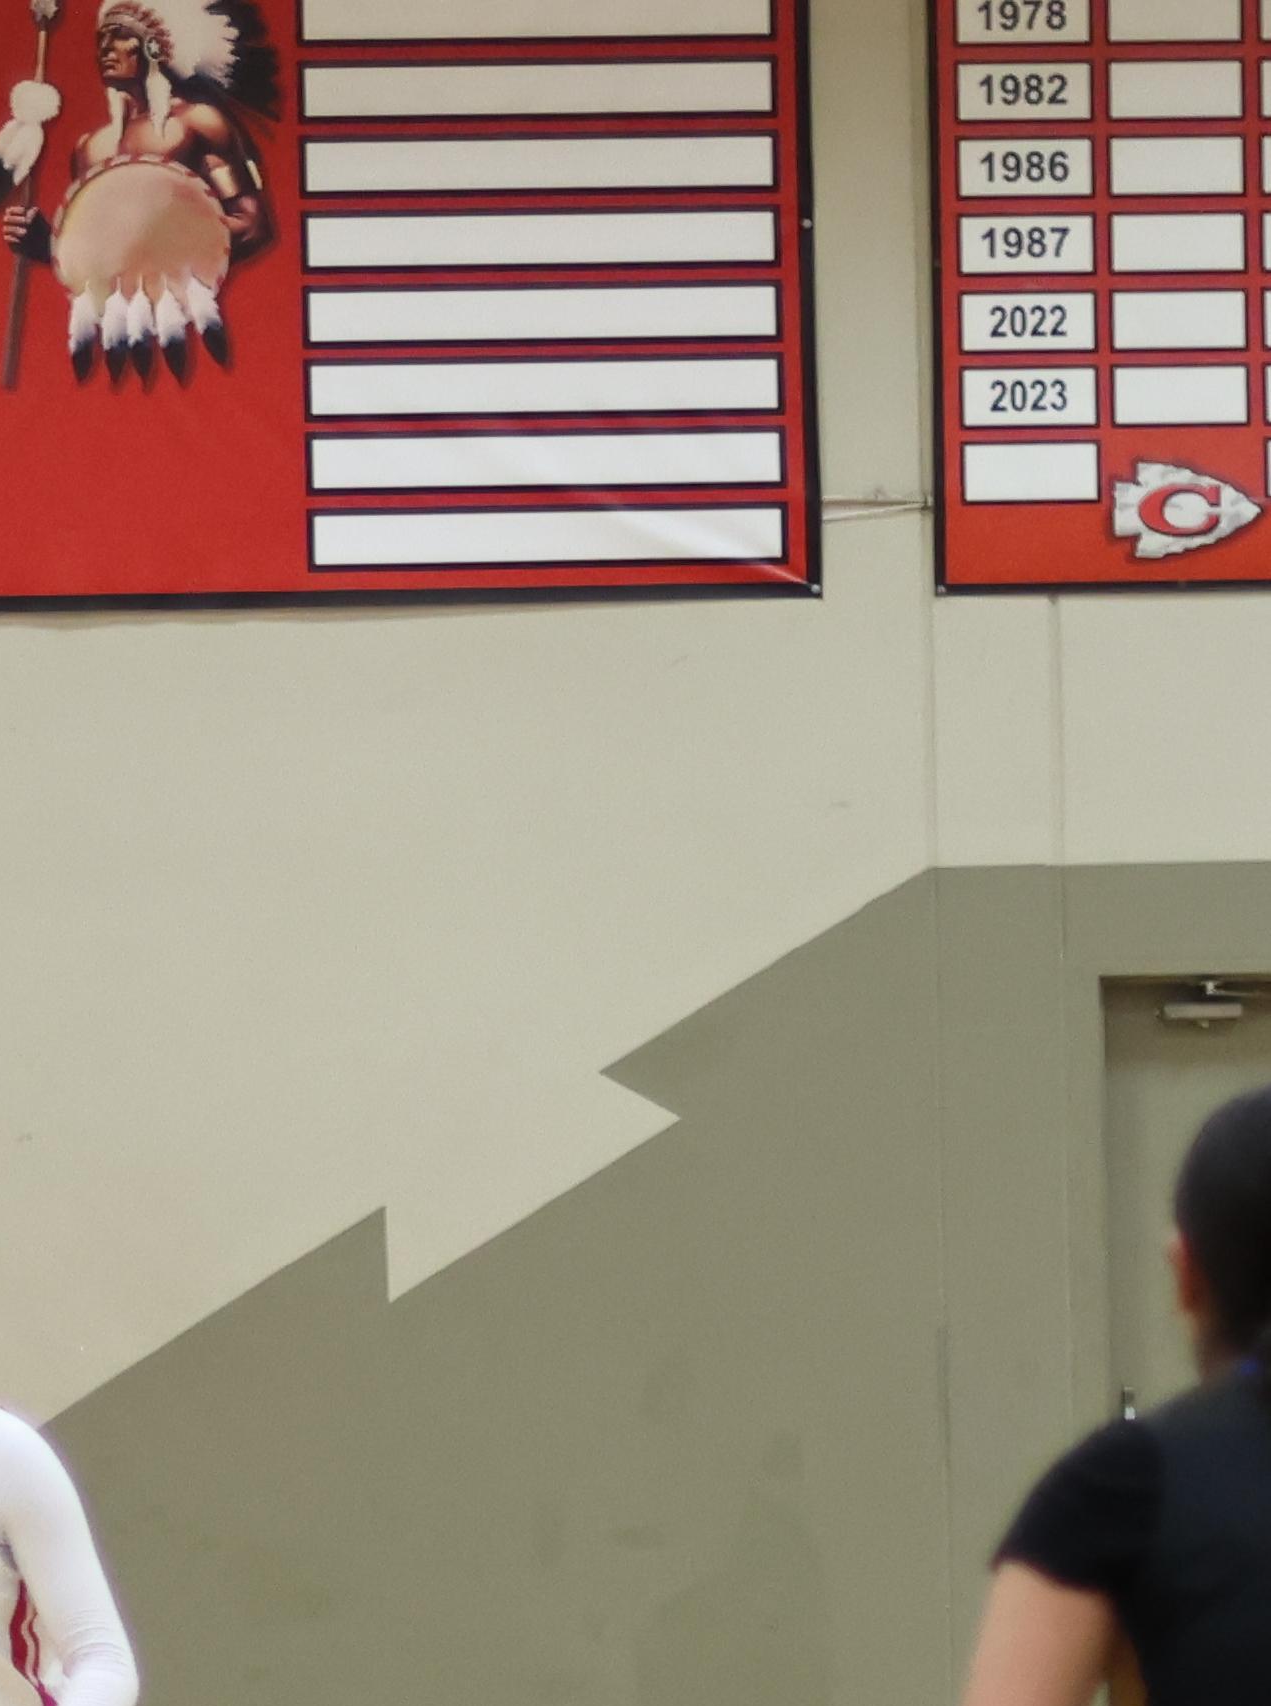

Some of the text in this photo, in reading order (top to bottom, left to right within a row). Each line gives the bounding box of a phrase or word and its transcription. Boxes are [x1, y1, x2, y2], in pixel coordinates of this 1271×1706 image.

[978, 0, 1067, 31] 1978
[979, 74, 1068, 105] 1982
[980, 151, 1069, 182] 1986
[981, 228, 1070, 259] 1987
[990, 305, 1068, 337] 2022
[990, 380, 1068, 412] 2023
[1138, 484, 1221, 536] C
